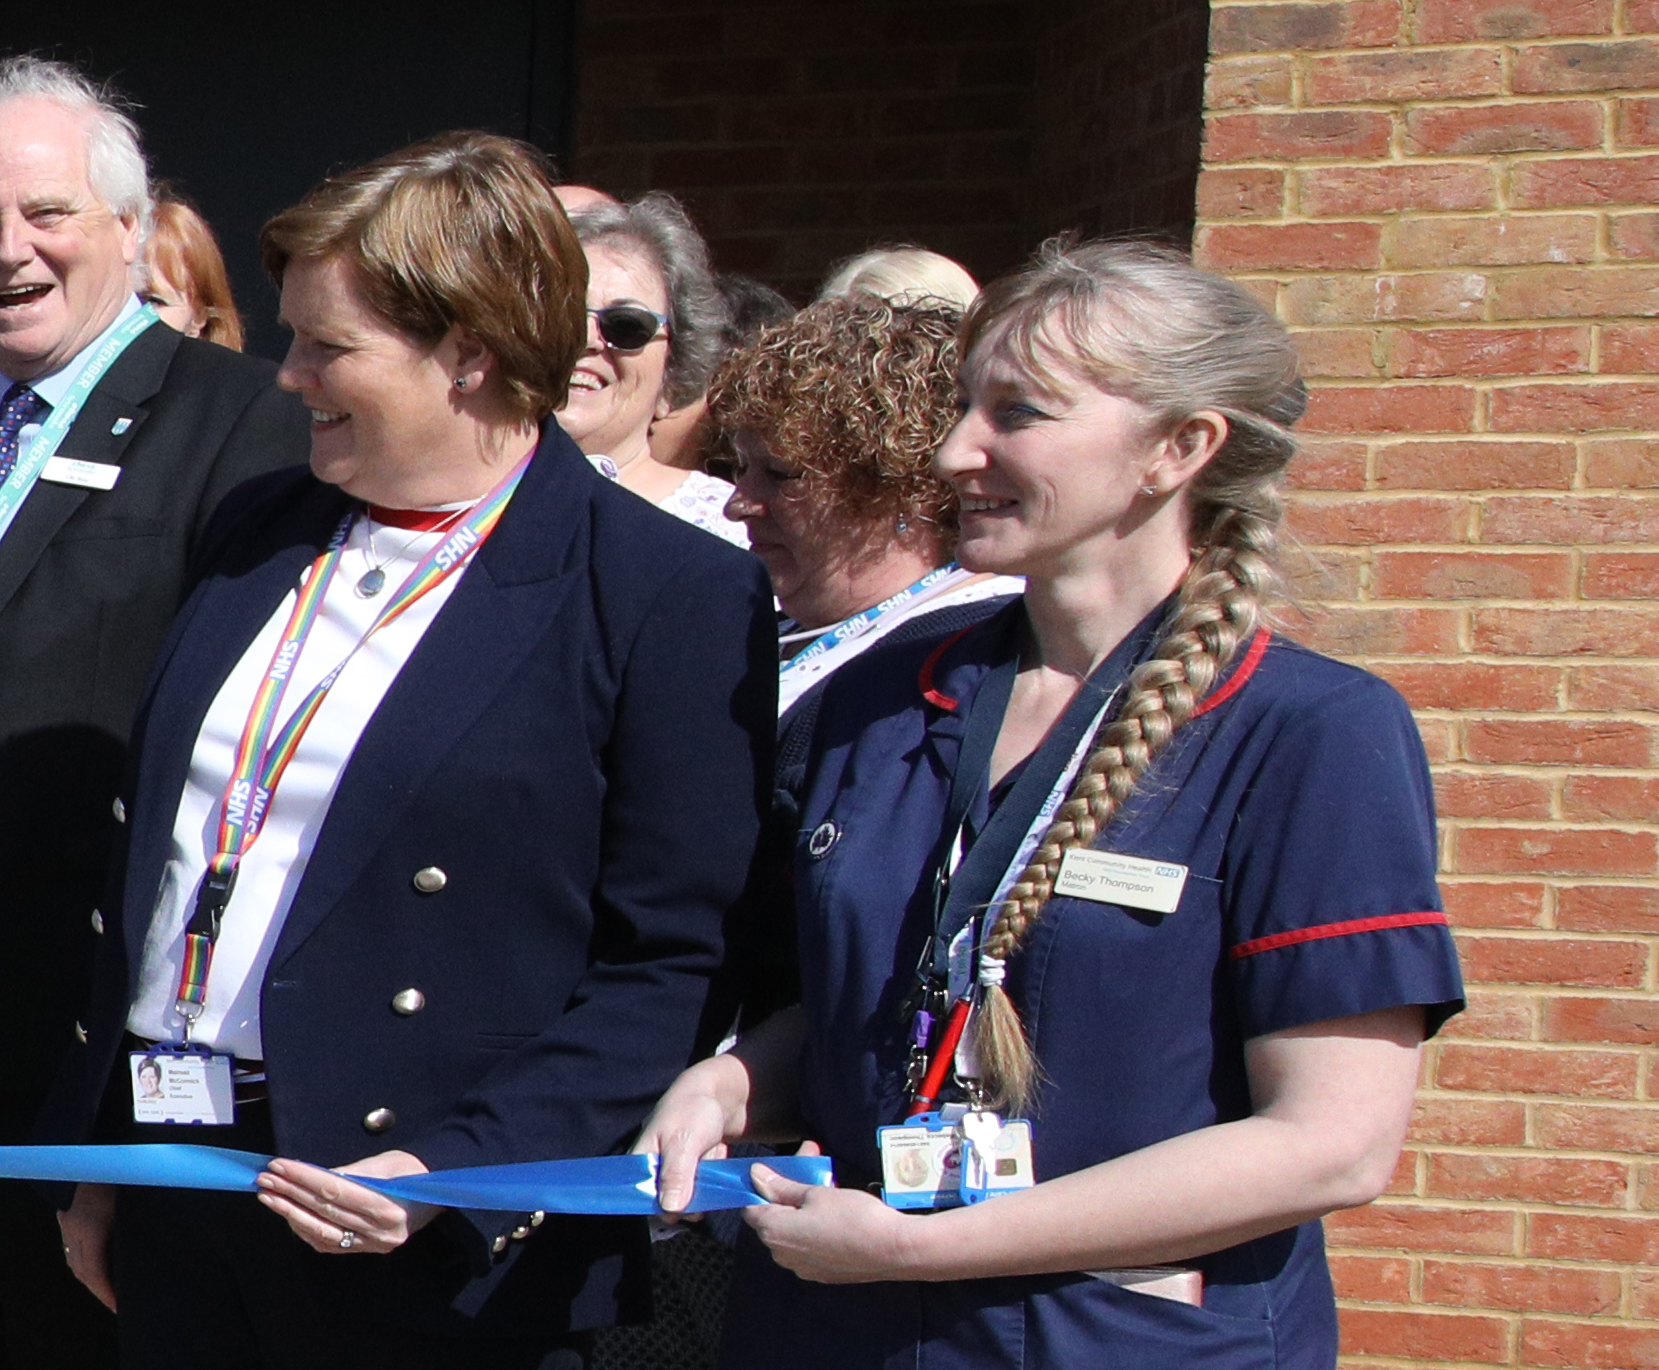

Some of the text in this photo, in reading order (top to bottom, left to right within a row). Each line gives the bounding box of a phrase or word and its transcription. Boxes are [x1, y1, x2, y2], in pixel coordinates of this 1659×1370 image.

[77, 338, 121, 388] MEMBER
[9, 436, 50, 490] MEMBER
[436, 526, 477, 571] NHS
[834, 613, 870, 643] NHS
[877, 589, 912, 614] NHS
[270, 640, 299, 680] NHS
[226, 780, 251, 826] NHS
[247, 787, 269, 833] NHS
[1039, 790, 1063, 817] NHS
[1061, 881, 1087, 891] Matron
[1064, 870, 1096, 884] Becky
[1100, 876, 1155, 893] Thompson
[1086, 857, 1128, 870] Community
[1128, 863, 1152, 872] Health
[1155, 866, 1180, 878] NHS
